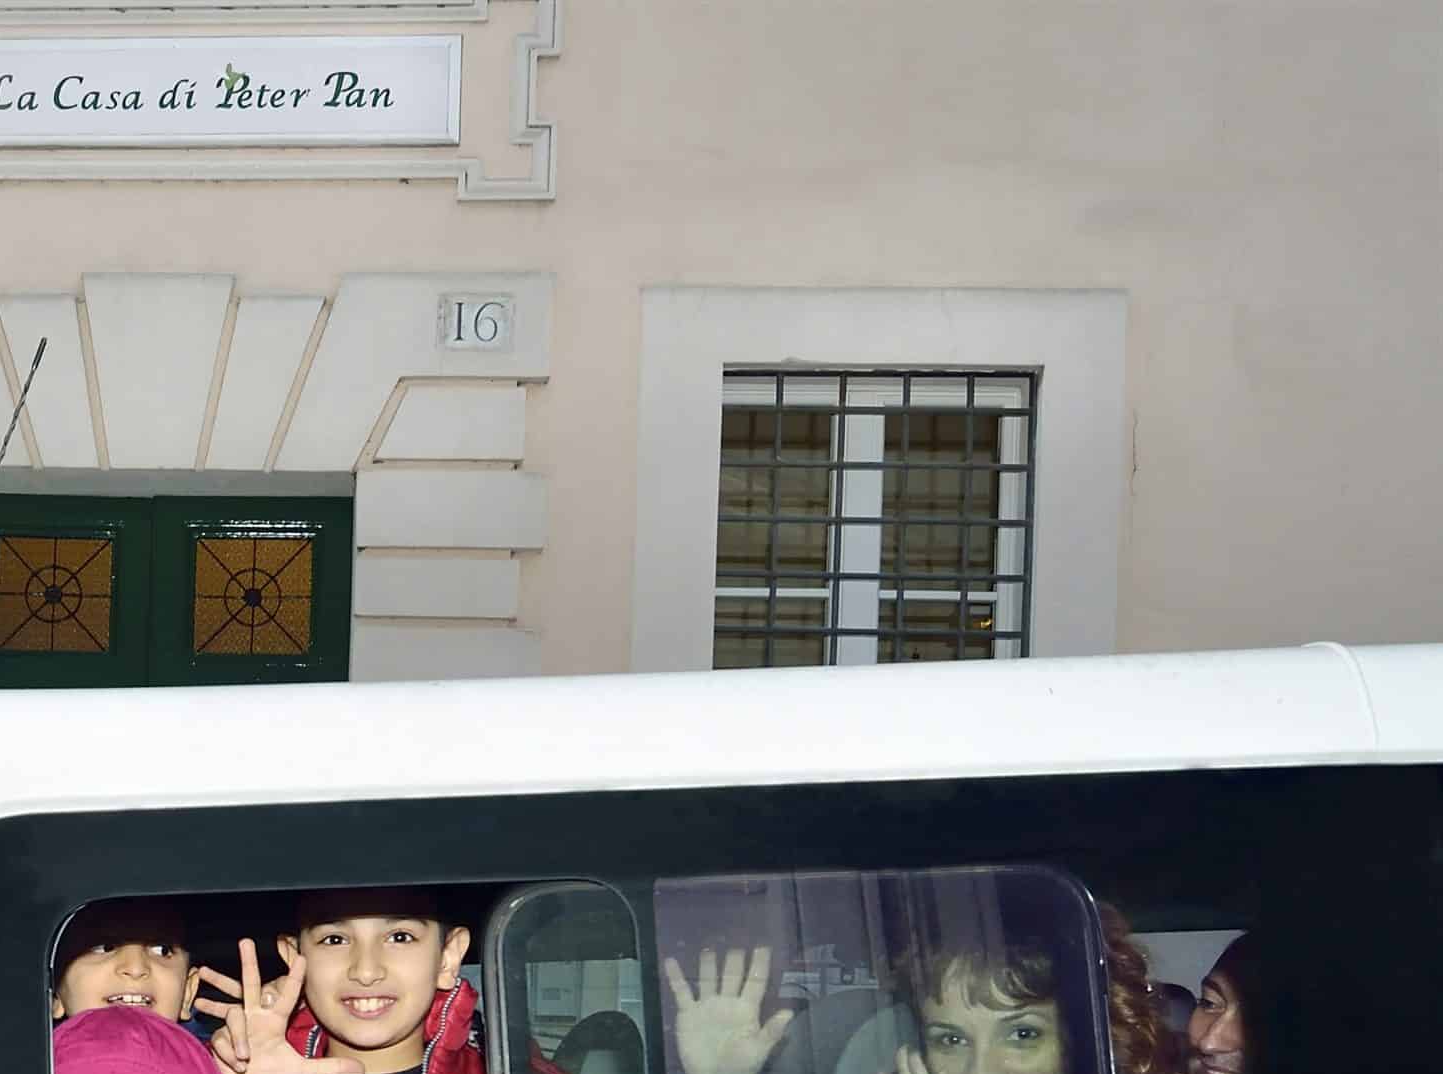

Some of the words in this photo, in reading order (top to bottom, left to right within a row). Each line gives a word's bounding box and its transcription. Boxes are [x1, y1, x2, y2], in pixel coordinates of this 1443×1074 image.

[53, 76, 144, 110] Casa
[159, 79, 197, 110] di
[215, 71, 310, 110] Peter
[323, 72, 395, 108] Pan
[453, 302, 505, 342] 16
